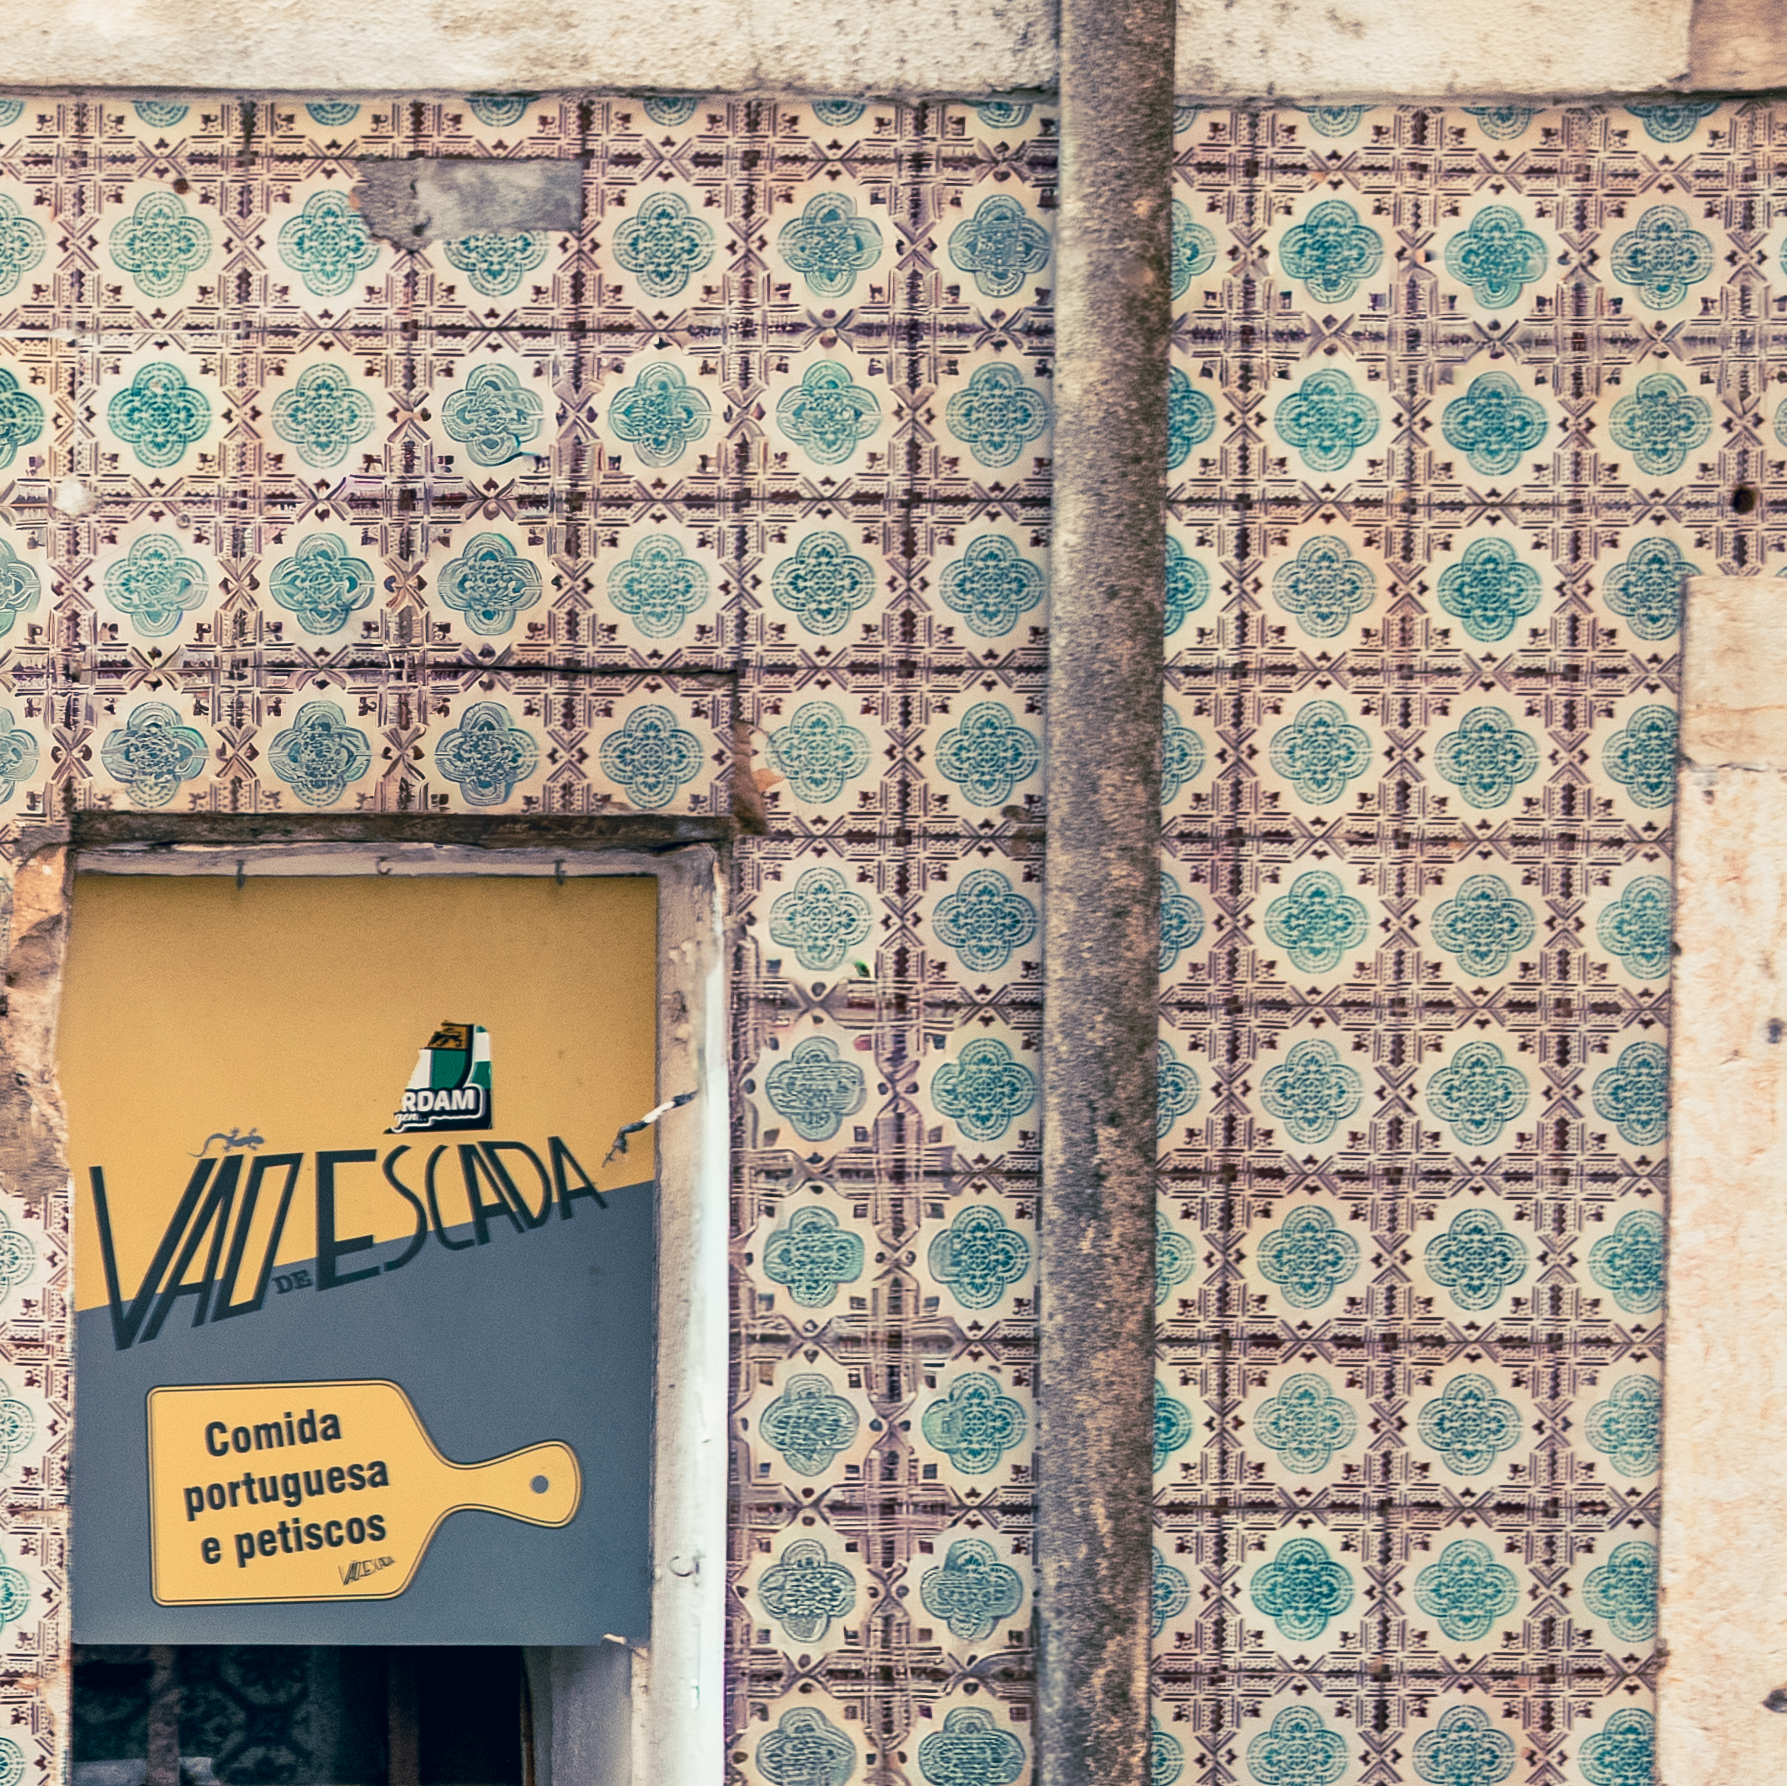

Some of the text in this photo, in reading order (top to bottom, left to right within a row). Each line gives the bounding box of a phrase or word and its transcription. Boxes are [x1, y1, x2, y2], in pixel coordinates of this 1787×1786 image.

[275, 1135, 608, 1296] DE ESCADA
[205, 1407, 342, 1458] Comida
[183, 1457, 390, 1523] portuguesa
[201, 1509, 387, 1568] e petiscos
